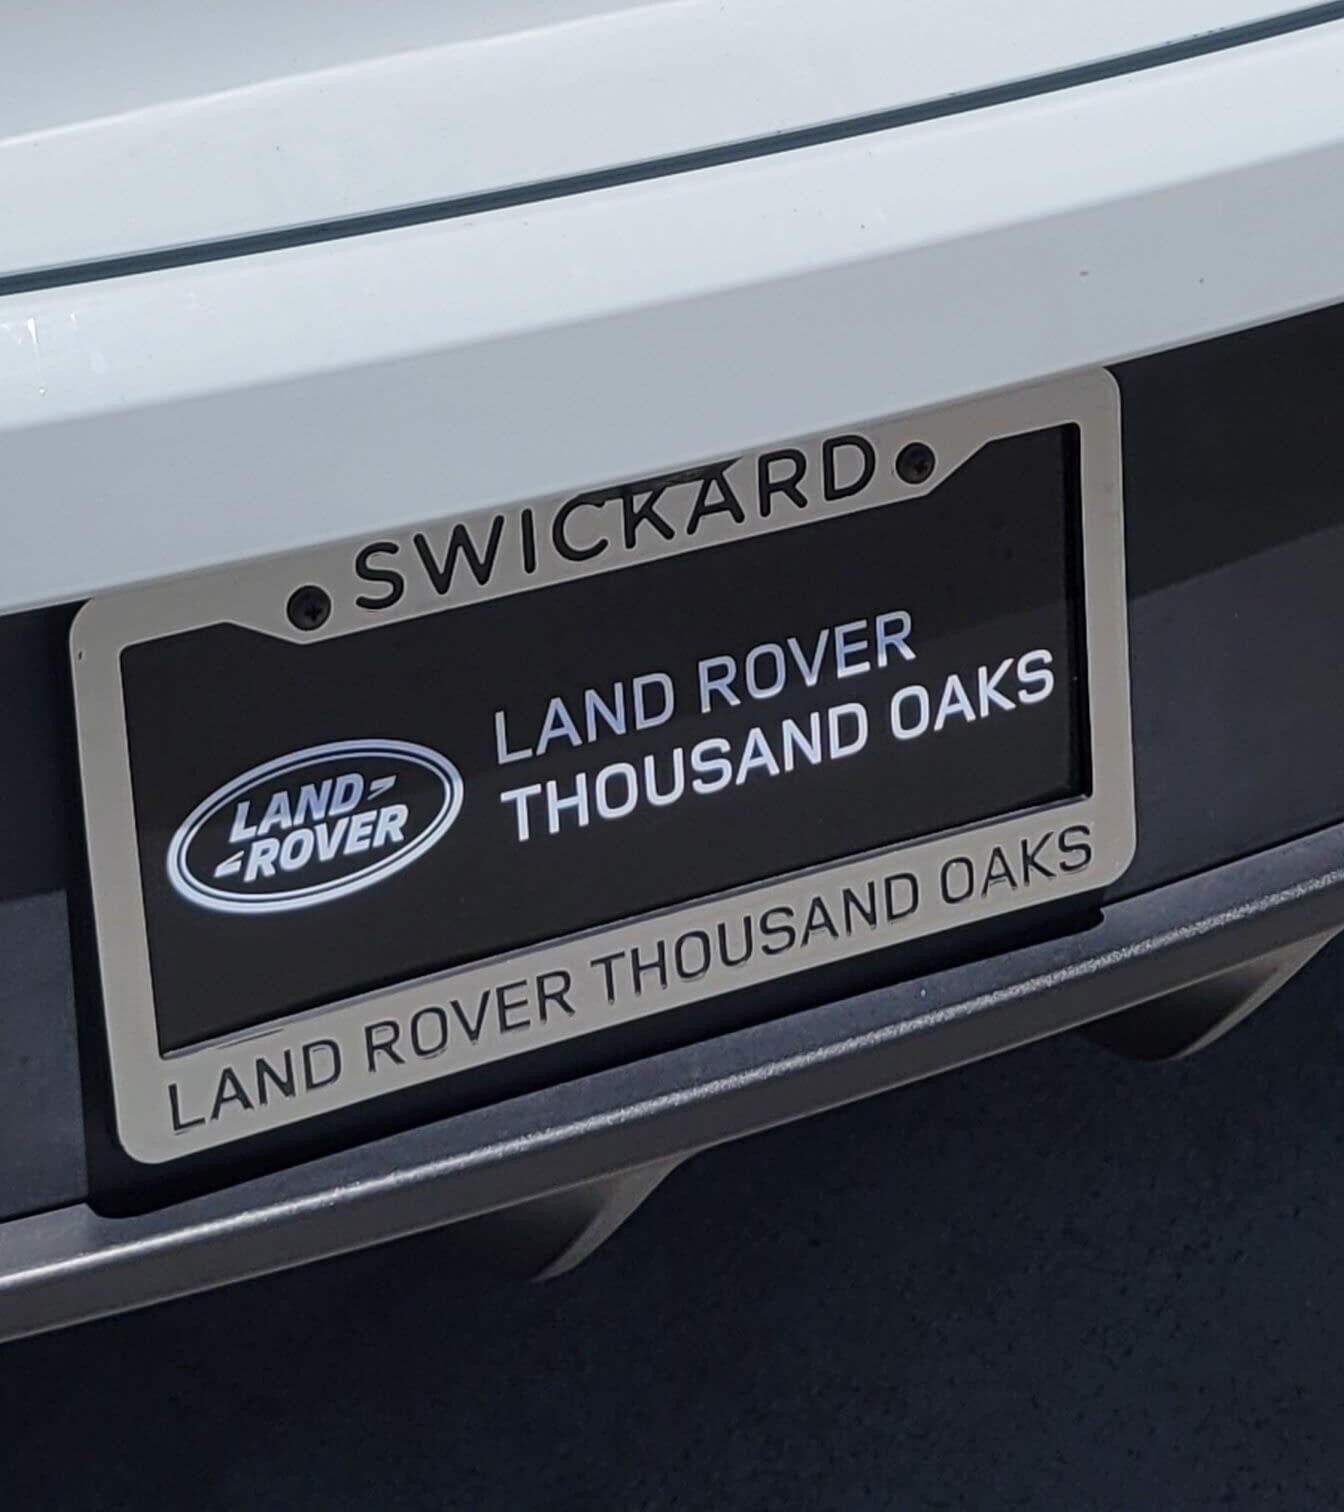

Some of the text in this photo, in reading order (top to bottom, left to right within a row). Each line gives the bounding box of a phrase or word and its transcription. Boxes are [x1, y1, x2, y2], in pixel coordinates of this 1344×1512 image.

[353, 434, 879, 612] SWICKARD
[494, 609, 917, 765] LAND ROVER
[500, 648, 1056, 842] THOUSAND OAKS
[230, 772, 365, 839] LAND
[243, 803, 409, 883] ROVER
[166, 822, 1096, 1136] LAND ROVER THOUSAND OAKS
